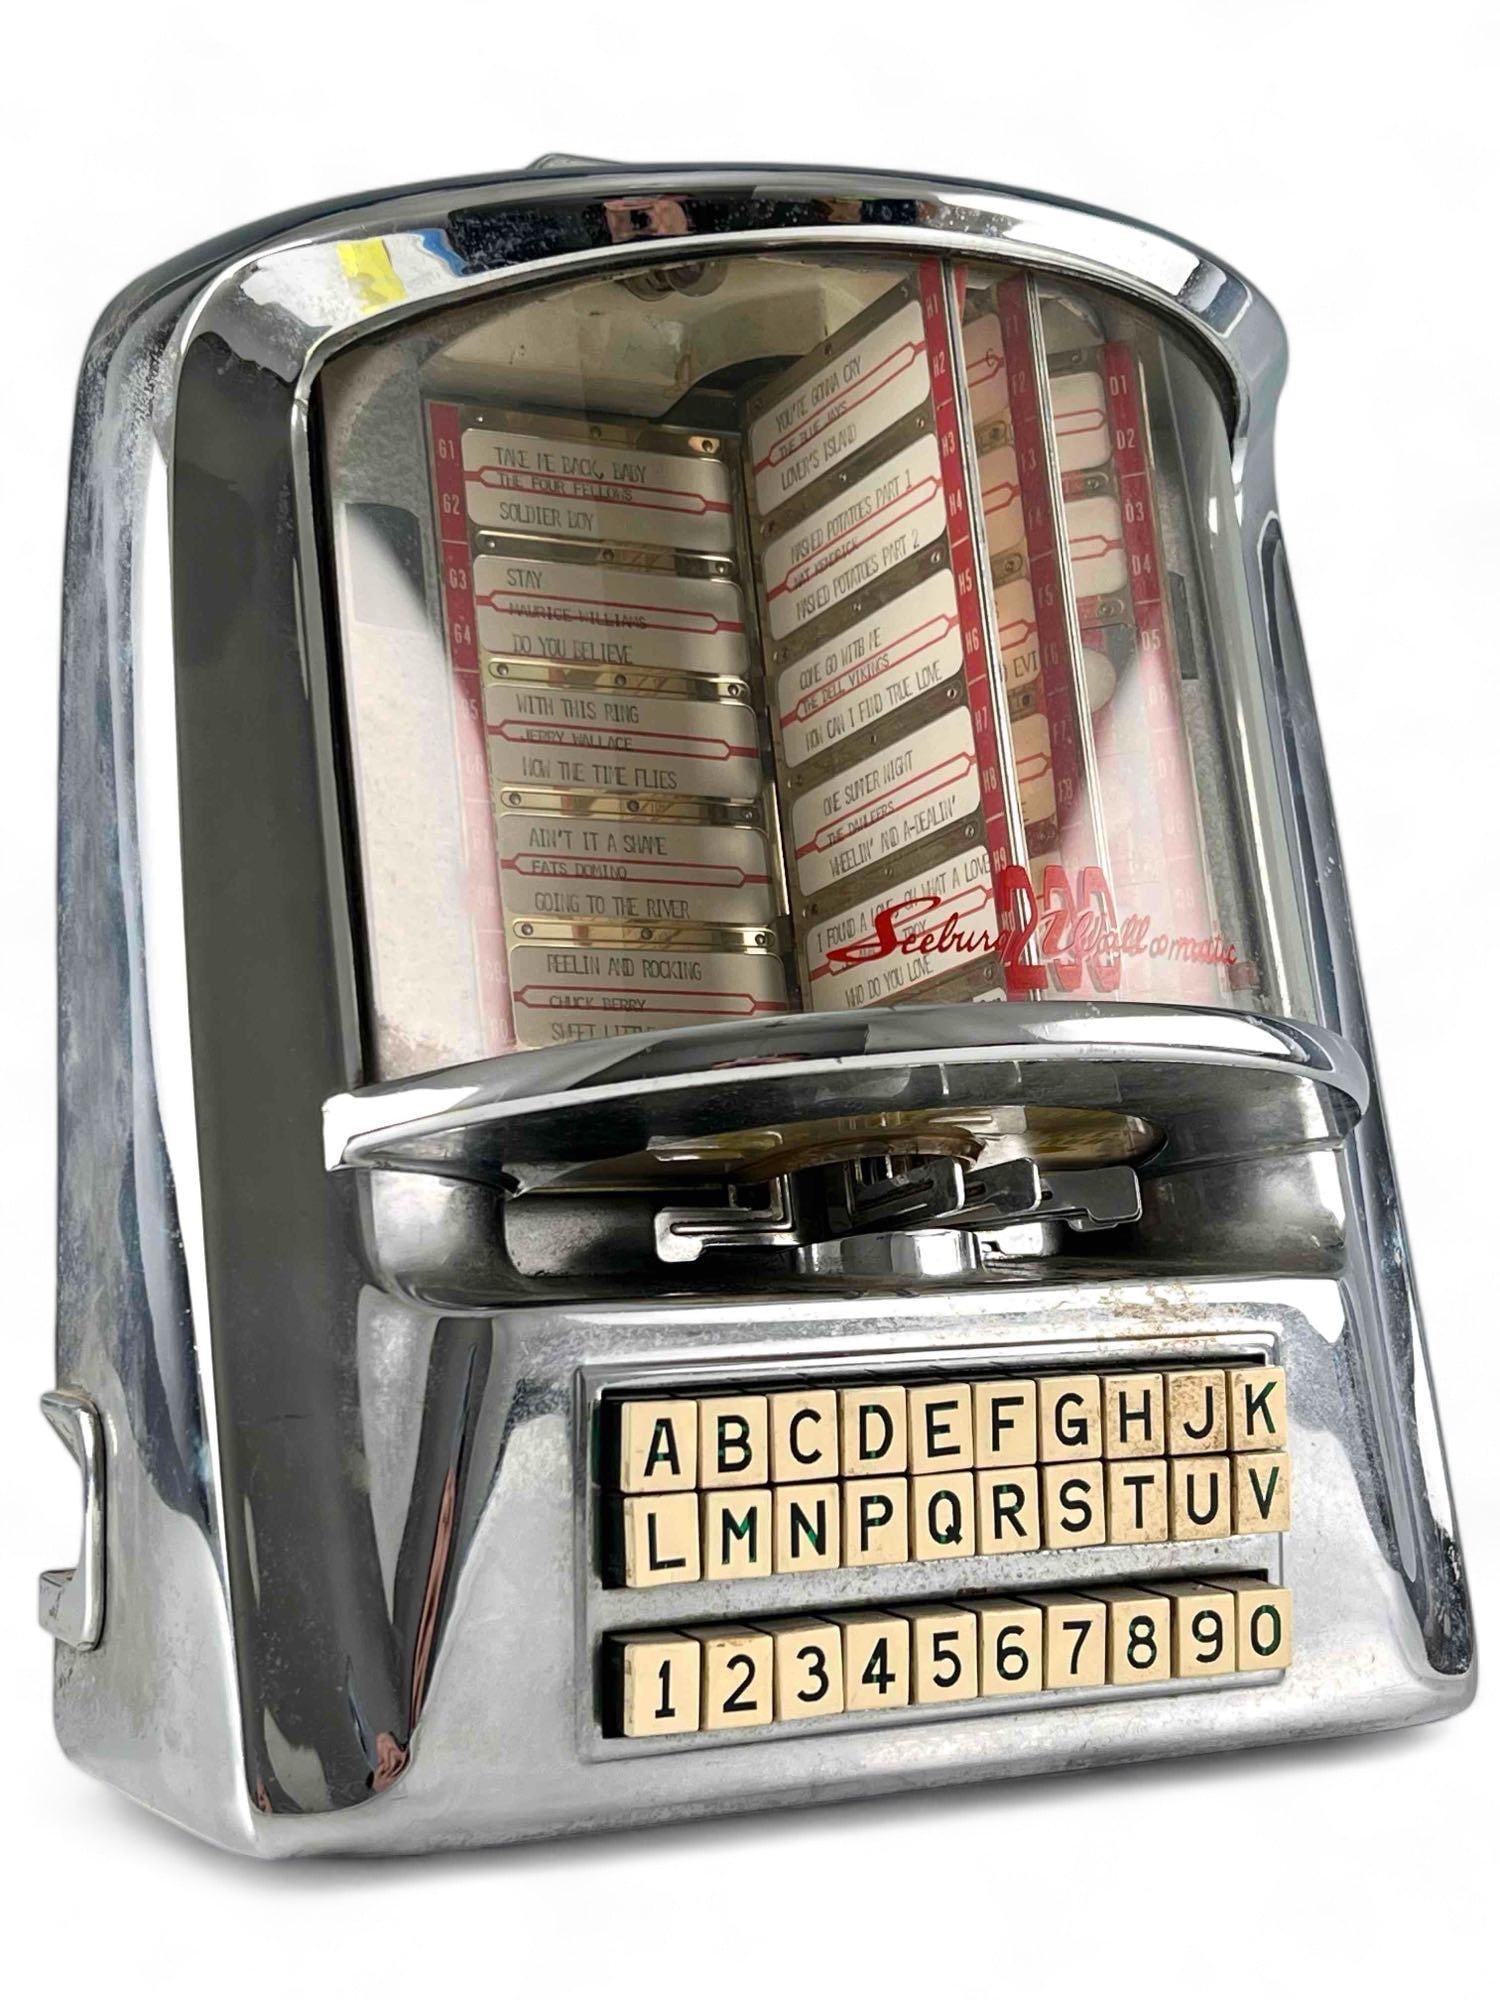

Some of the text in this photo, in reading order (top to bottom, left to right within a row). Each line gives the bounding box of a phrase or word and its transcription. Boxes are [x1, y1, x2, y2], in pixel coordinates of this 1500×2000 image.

[926, 297, 939, 319] H1
[842, 356, 863, 385] CRY
[933, 351, 947, 377] H2
[1109, 375, 1128, 397] D1
[942, 430, 957, 457] H3
[1116, 428, 1136, 450] D2
[531, 476, 569, 494] FOUR
[613, 462, 648, 484] BABY
[874, 480, 902, 513] PART
[904, 468, 914, 491] 1
[949, 487, 964, 513] H4
[499, 501, 563, 529] SOLDIER
[1124, 500, 1146, 524] D3
[881, 537, 909, 568] PART
[911, 527, 922, 549] 2
[1131, 552, 1152, 576] D4
[506, 566, 544, 590] STAY
[958, 570, 973, 594] H5
[513, 633, 633, 665] DO YOU BELIEVE
[965, 627, 980, 654] H6
[1140, 629, 1161, 651] D5
[825, 653, 839, 676] GO
[516, 693, 640, 725] WITH THIS RING
[827, 715, 847, 742] CAN
[887, 676, 914, 706] TRUE
[915, 659, 943, 692] LOVE
[974, 705, 989, 735] H7
[572, 731, 634, 752] WALLACE
[634, 766, 678, 790] FLIES
[882, 748, 915, 785] NIGHT
[983, 762, 998, 792] H8
[528, 826, 668, 857] AIN'T IT A SHAME
[879, 822, 900, 855] AND
[531, 860, 628, 882] FATS DOMINO
[534, 891, 691, 920] GOING TO THE RIVER
[816, 932, 824, 952] I
[859, 911, 868, 933] A
[951, 866, 961, 889] A
[963, 854, 990, 884] LOVE
[826, 896, 1013, 966] Seeburg
[608, 957, 635, 979] AND
[641, 958, 702, 982] ROCKING
[867, 976, 882, 999] DO
[883, 966, 905, 992] YOU
[906, 955, 933, 982] LOVE
[644, 1382, 1276, 1476] A B C D E F G H J K
[648, 1467, 1279, 1570] L M N P Q R S T U V
[655, 1605, 1281, 1718] 1 2 3 4 5 6 7 8 9 0
